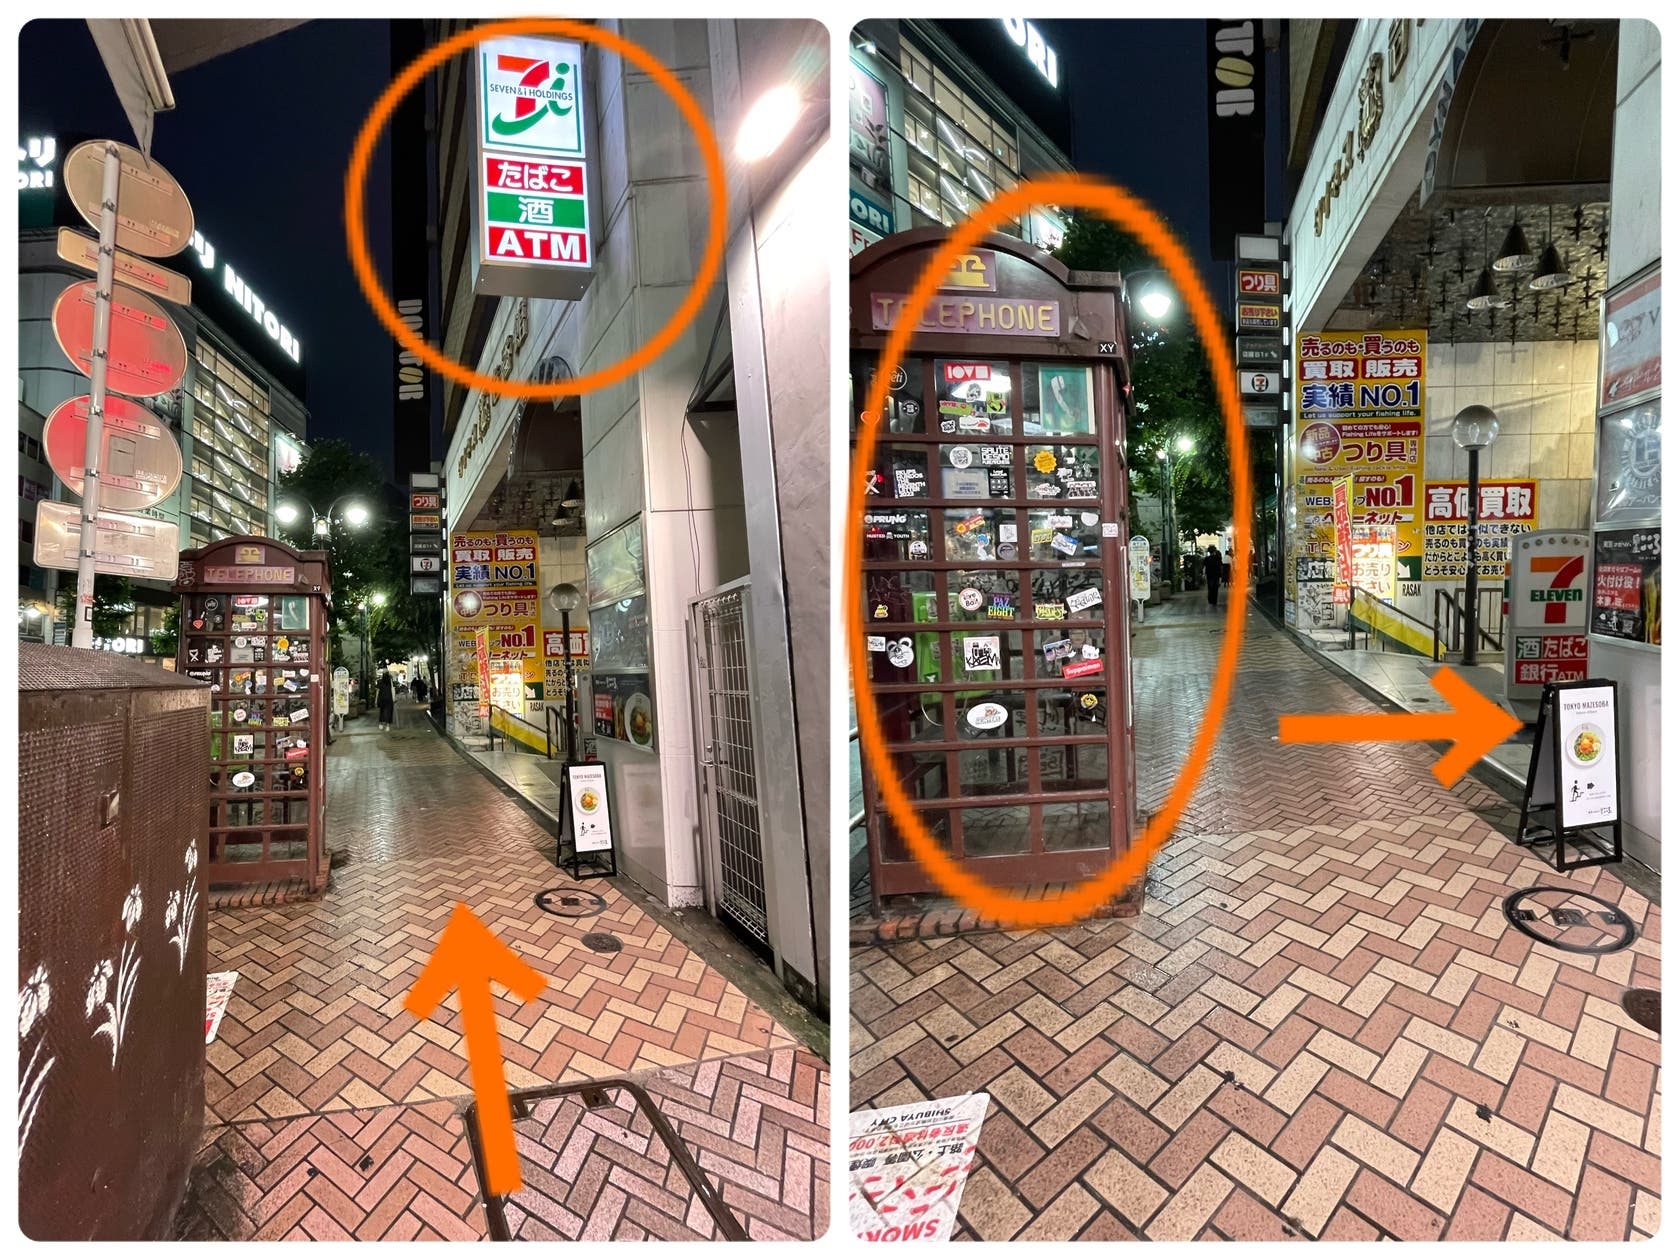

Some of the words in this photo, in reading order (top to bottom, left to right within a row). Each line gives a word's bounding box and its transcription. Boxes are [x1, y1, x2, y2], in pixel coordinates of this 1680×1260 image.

[490, 83, 528, 96] SEVEN&i
[529, 89, 573, 101] HOLDINGS
[497, 161, 573, 192] たばこ
[518, 196, 554, 225] 酒
[496, 229, 580, 261] ATM
[1242, 274, 1277, 292] つり具
[224, 263, 300, 364] NITORI
[877, 298, 1054, 332] TLEPHONE
[398, 298, 425, 400] DOTOR
[1100, 344, 1115, 353] XY
[1301, 335, 1420, 357] 売るのも・買うのも
[1303, 361, 1355, 379] 買取
[1365, 359, 1418, 378] 販売
[1302, 382, 1354, 409] 実績
[1361, 380, 1420, 408] NO.1
[1342, 441, 1407, 462] つり具
[1366, 475, 1415, 509] NO.1
[1425, 524, 1531, 536] 他店では似できない
[455, 551, 490, 561] 買取
[497, 549, 534, 561] 販売
[207, 568, 291, 581] TELEPHONE
[455, 564, 490, 581] 実績
[495, 562, 536, 580] NO.1
[483, 602, 529, 616] つり具
[987, 605, 1015, 617] EIGHT
[501, 625, 536, 648] NO.1
[1517, 637, 1541, 659] 酒
[1544, 636, 1588, 658] たばこ
[1519, 663, 1558, 682] 銀行
[1558, 670, 1584, 681] ATM
[1564, 701, 1581, 711] TOKYO
[1582, 700, 1609, 709] MAZESOBA
[901, 1107, 952, 1122] SHIBUYA
[858, 1219, 940, 1242] SMOK
